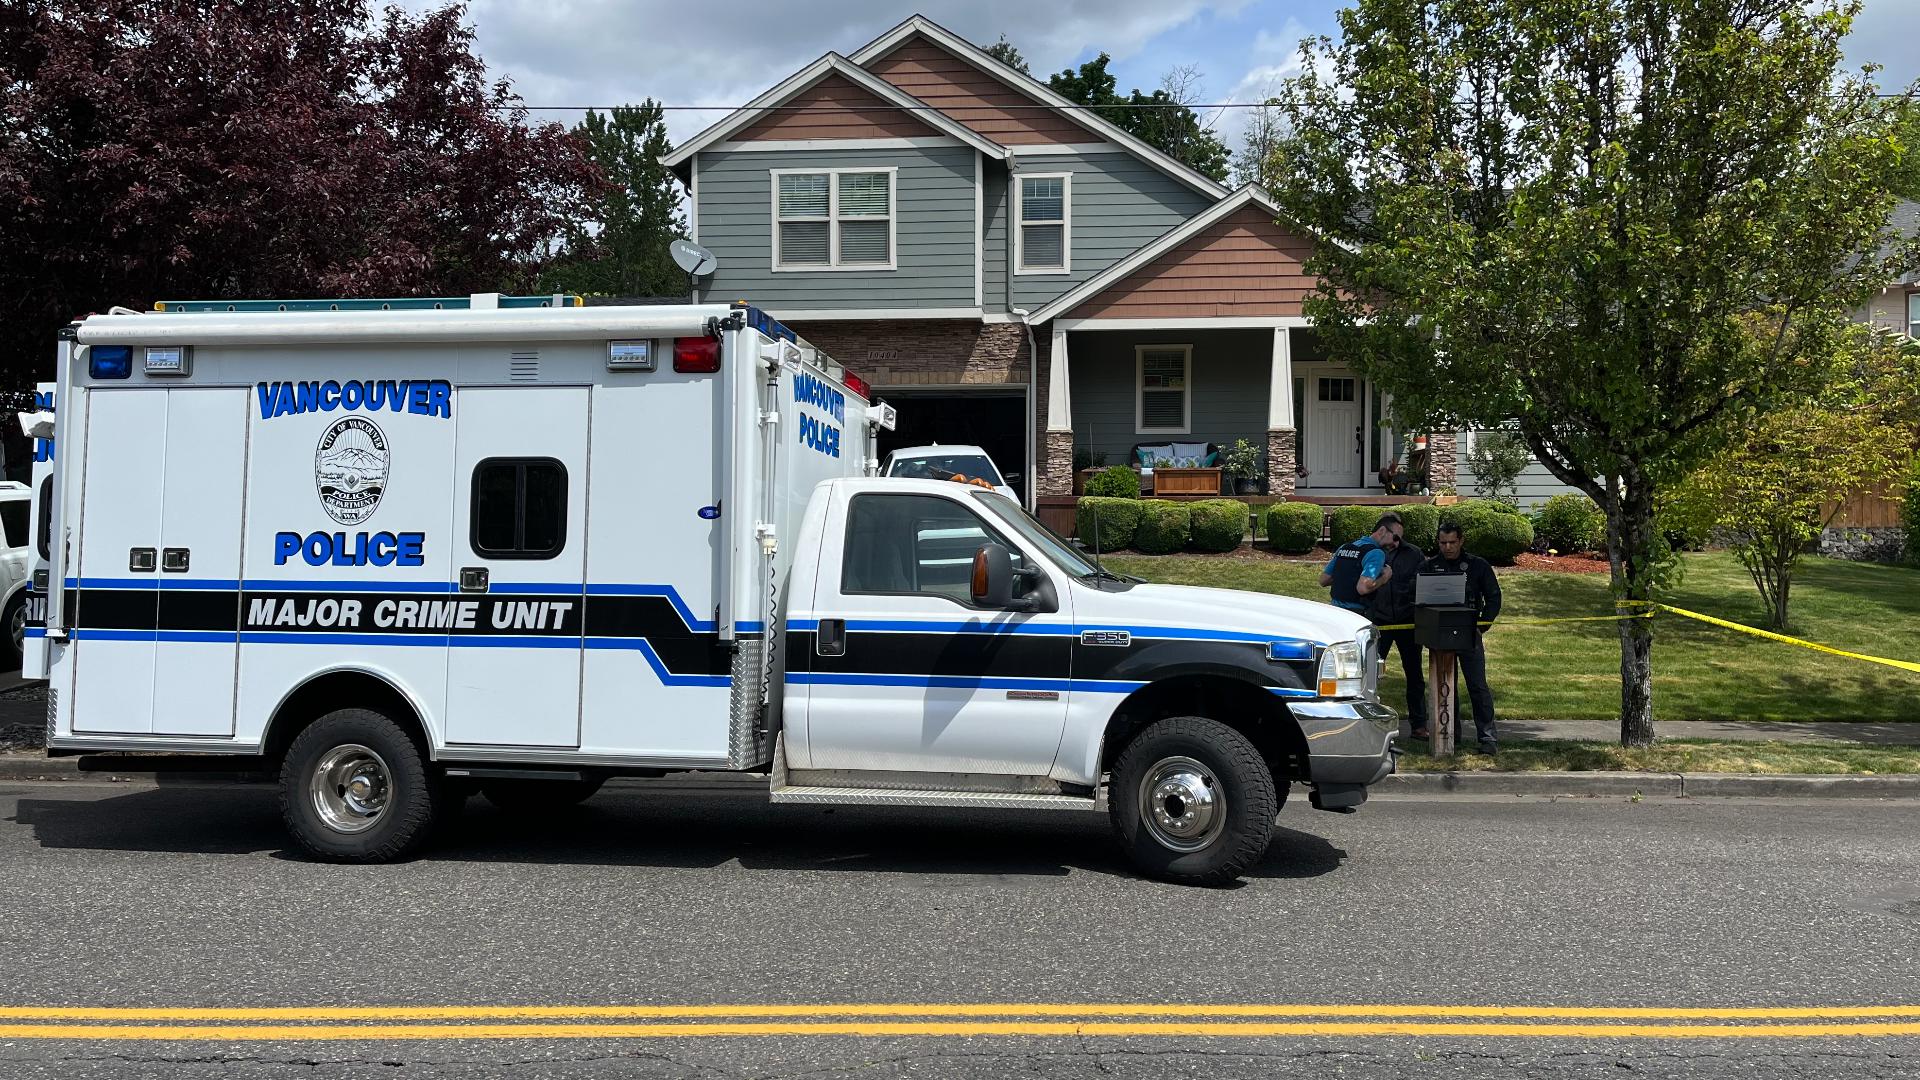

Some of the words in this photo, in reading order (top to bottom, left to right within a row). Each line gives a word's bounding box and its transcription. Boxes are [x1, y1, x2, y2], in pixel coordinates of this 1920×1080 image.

[257, 380, 452, 419] VANCOUVER
[793, 370, 844, 428] VANCOUVER
[323, 430, 337, 448] CITY
[337, 422, 346, 432] OF
[349, 420, 383, 448] VANCOUVER
[799, 411, 840, 458] POLICE
[326, 496, 375, 508] DEPARTMENT
[332, 490, 371, 499] POLICE
[274, 531, 425, 567] POLICE
[1337, 549, 1360, 558] POLICE
[248, 599, 362, 627] MAJOR
[373, 600, 479, 628] CRIME
[491, 602, 572, 630] UNIT
[1439, 671, 1450, 739] 10404
